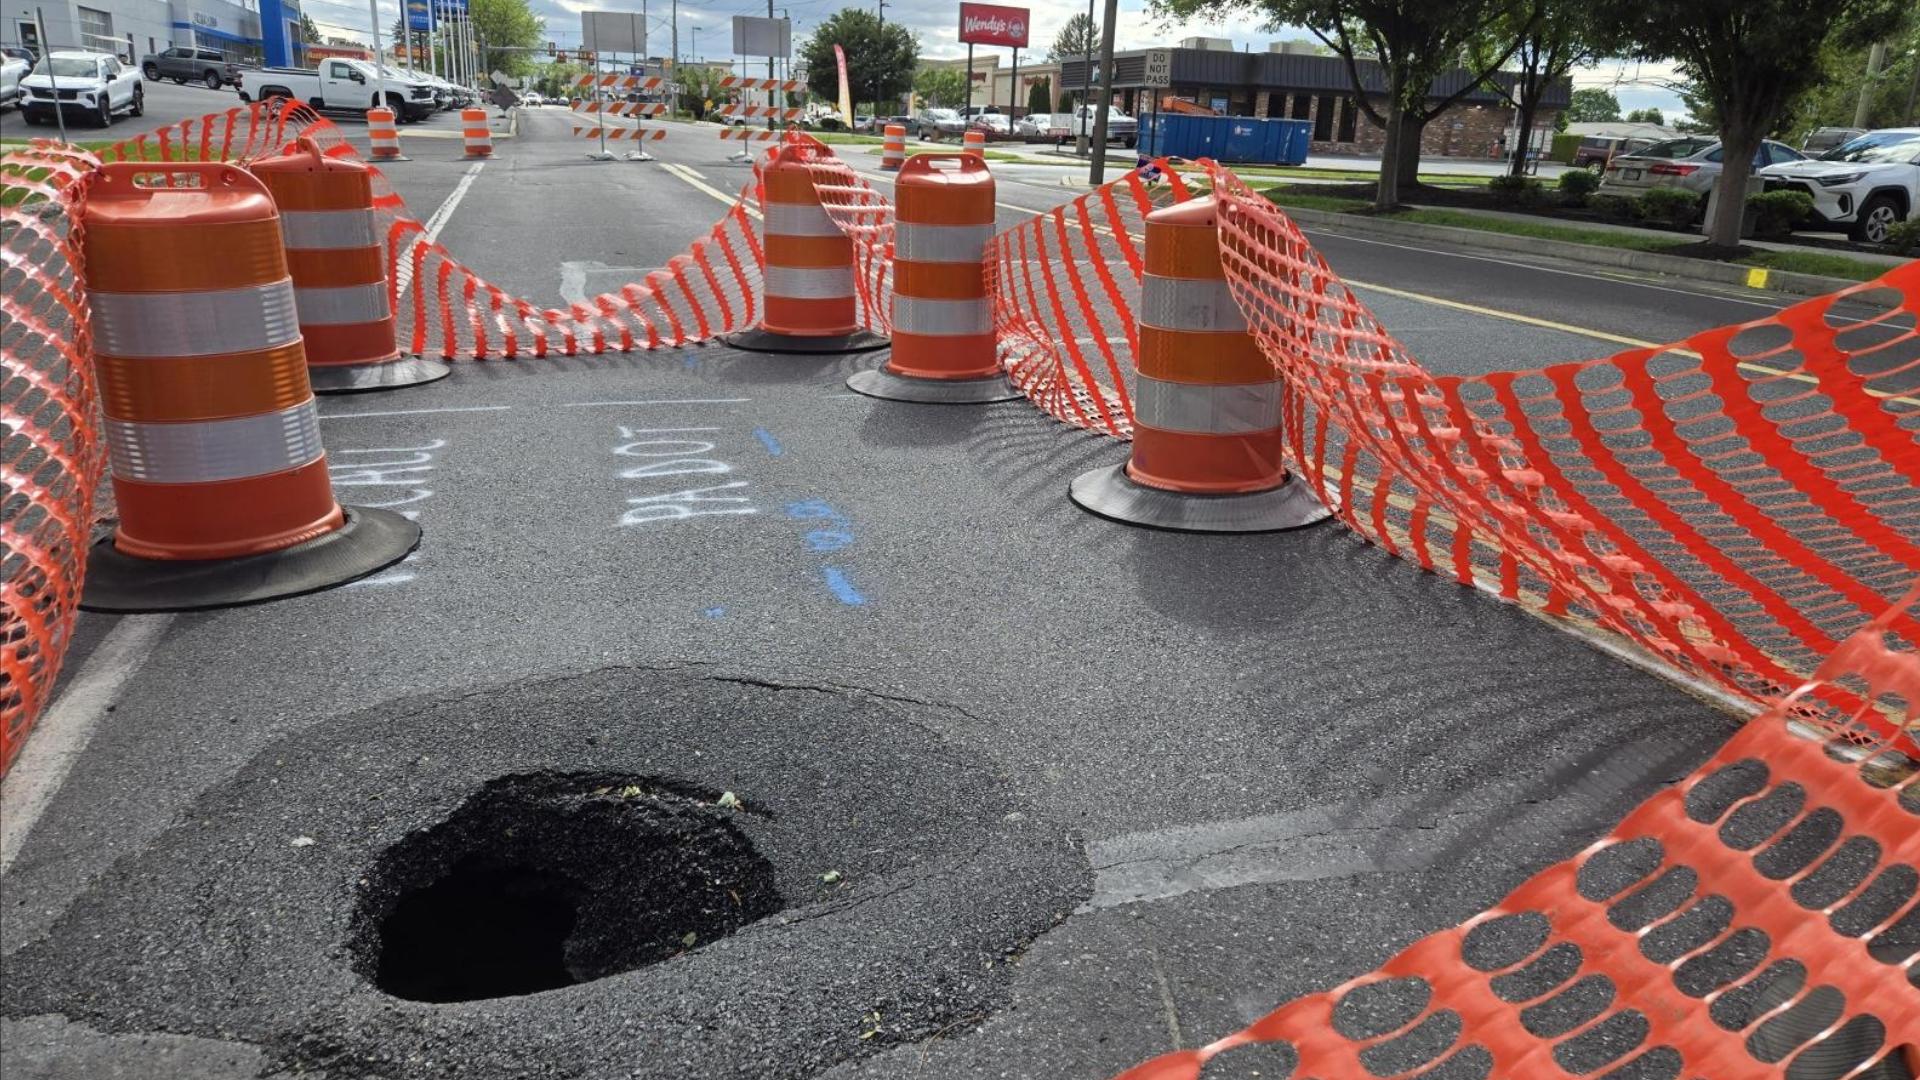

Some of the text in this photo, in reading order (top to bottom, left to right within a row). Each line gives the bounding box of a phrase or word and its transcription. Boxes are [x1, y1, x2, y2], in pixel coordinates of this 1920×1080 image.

[965, 15, 1006, 35] Wendy's
[1153, 53, 1165, 62] DO
[1150, 65, 1167, 73] NOT
[1145, 75, 1168, 85] PASS
